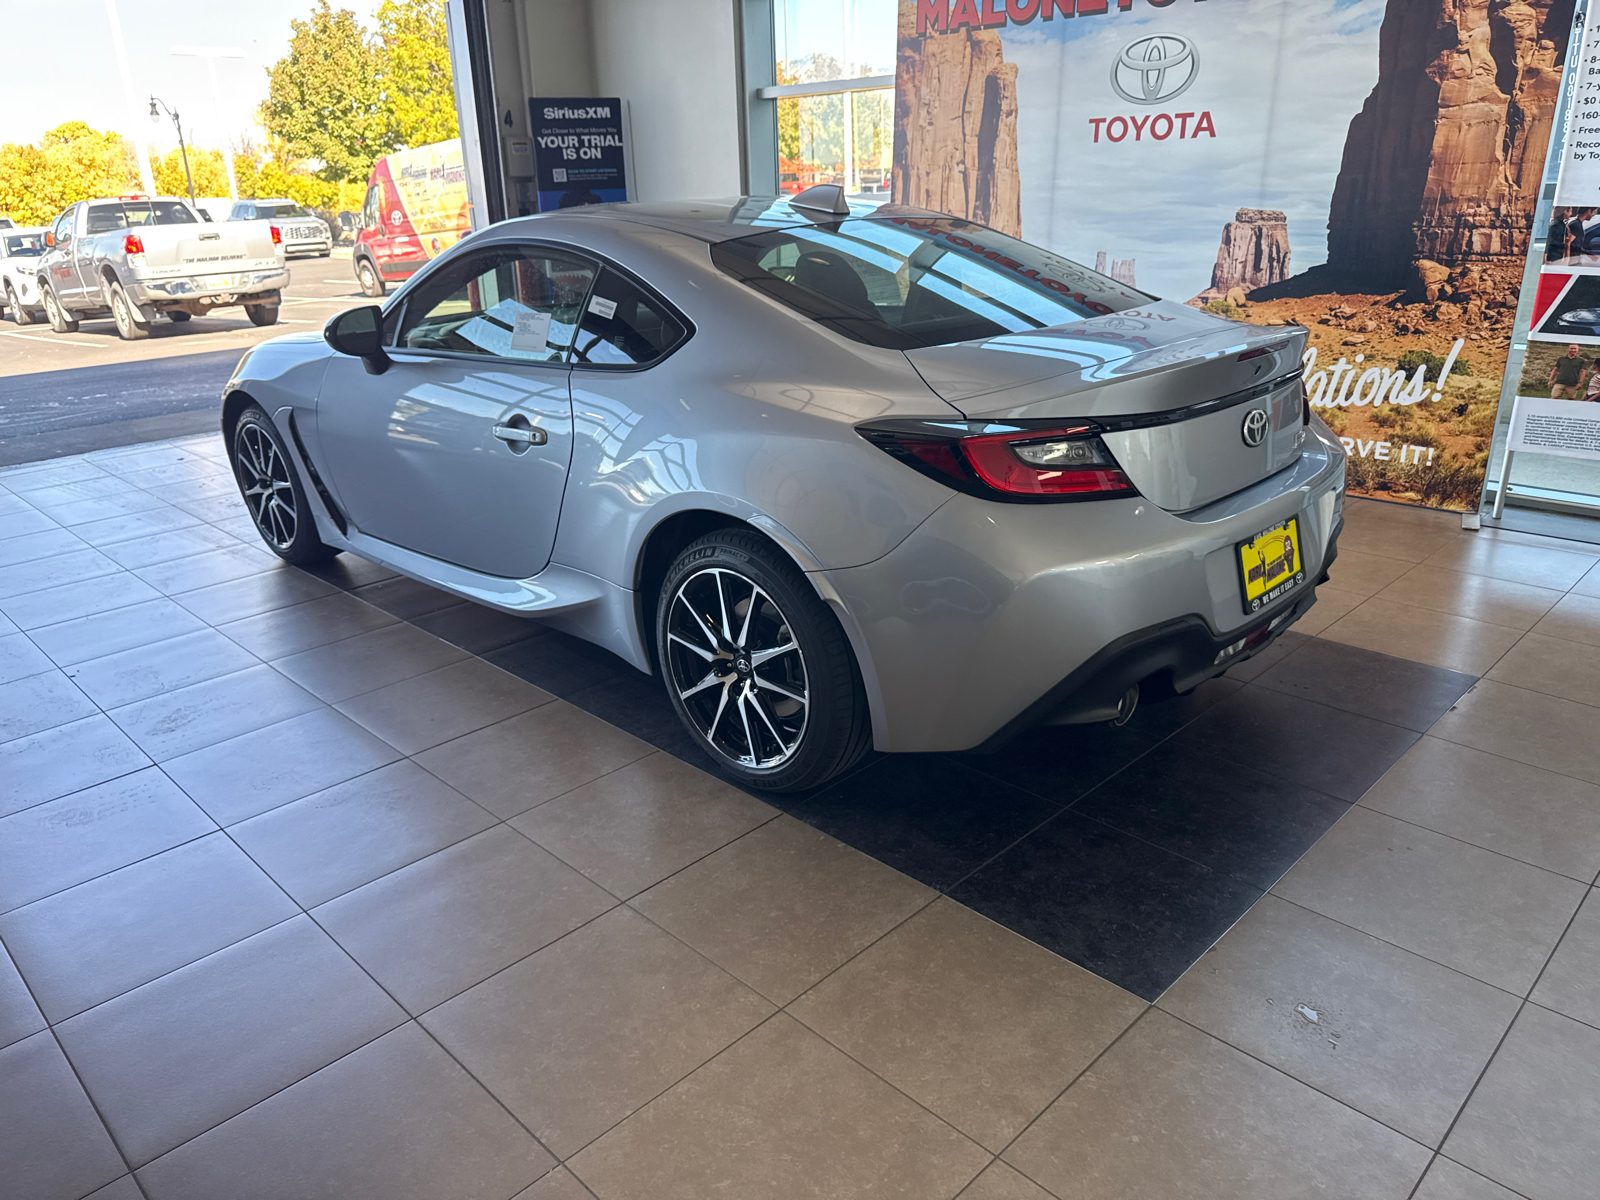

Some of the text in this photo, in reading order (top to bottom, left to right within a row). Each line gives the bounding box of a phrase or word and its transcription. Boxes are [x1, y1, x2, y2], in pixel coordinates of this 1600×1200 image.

[1583, 96, 1597, 105] $0
[504, 109, 513, 128] 4
[543, 107, 611, 119] SiriusXM
[1089, 111, 1216, 143] TOYOTA
[537, 135, 579, 148] YOUR
[581, 134, 623, 147] TRIAL
[562, 147, 602, 160] IS ON
[1574, 152, 1586, 161] by
[1400, 444, 1434, 466] IT!
[1285, 540, 1291, 550] 32
[669, 546, 714, 582] MICHELIN
[1262, 594, 1269, 604] WE
[1269, 587, 1280, 601] MAKE
[1284, 579, 1294, 591] EASY
